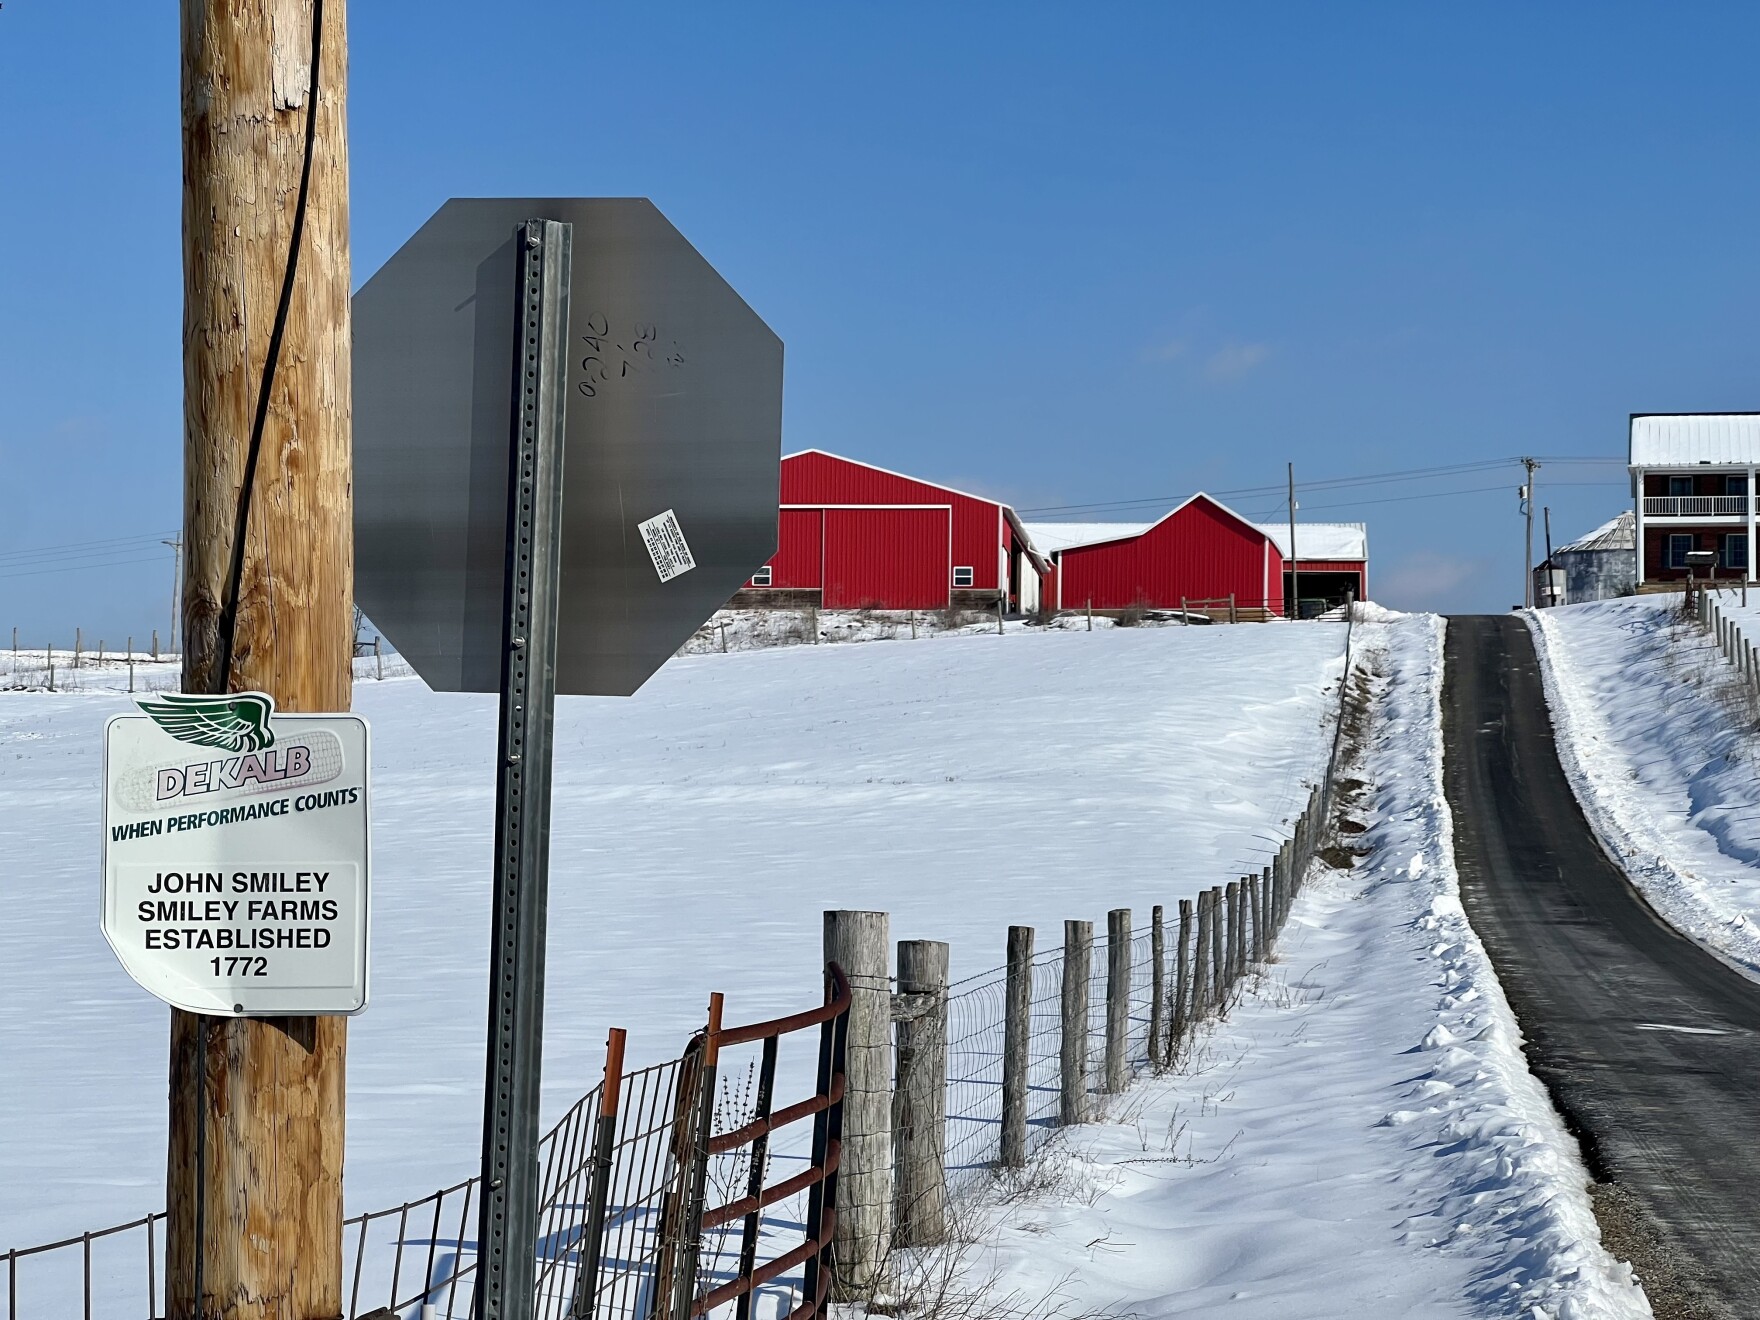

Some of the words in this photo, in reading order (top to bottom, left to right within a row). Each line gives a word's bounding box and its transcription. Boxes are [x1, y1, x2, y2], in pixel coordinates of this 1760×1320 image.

[156, 745, 311, 801] DEKALB
[111, 819, 163, 842] WHEN
[166, 799, 290, 834] PERFORMANCE
[147, 872, 223, 894] JOHN
[231, 872, 330, 893] SMILEY
[137, 900, 240, 922] SMILEY
[247, 900, 339, 921] FARMS
[145, 928, 331, 950] ESTABLISHED
[210, 957, 269, 977] 1772
